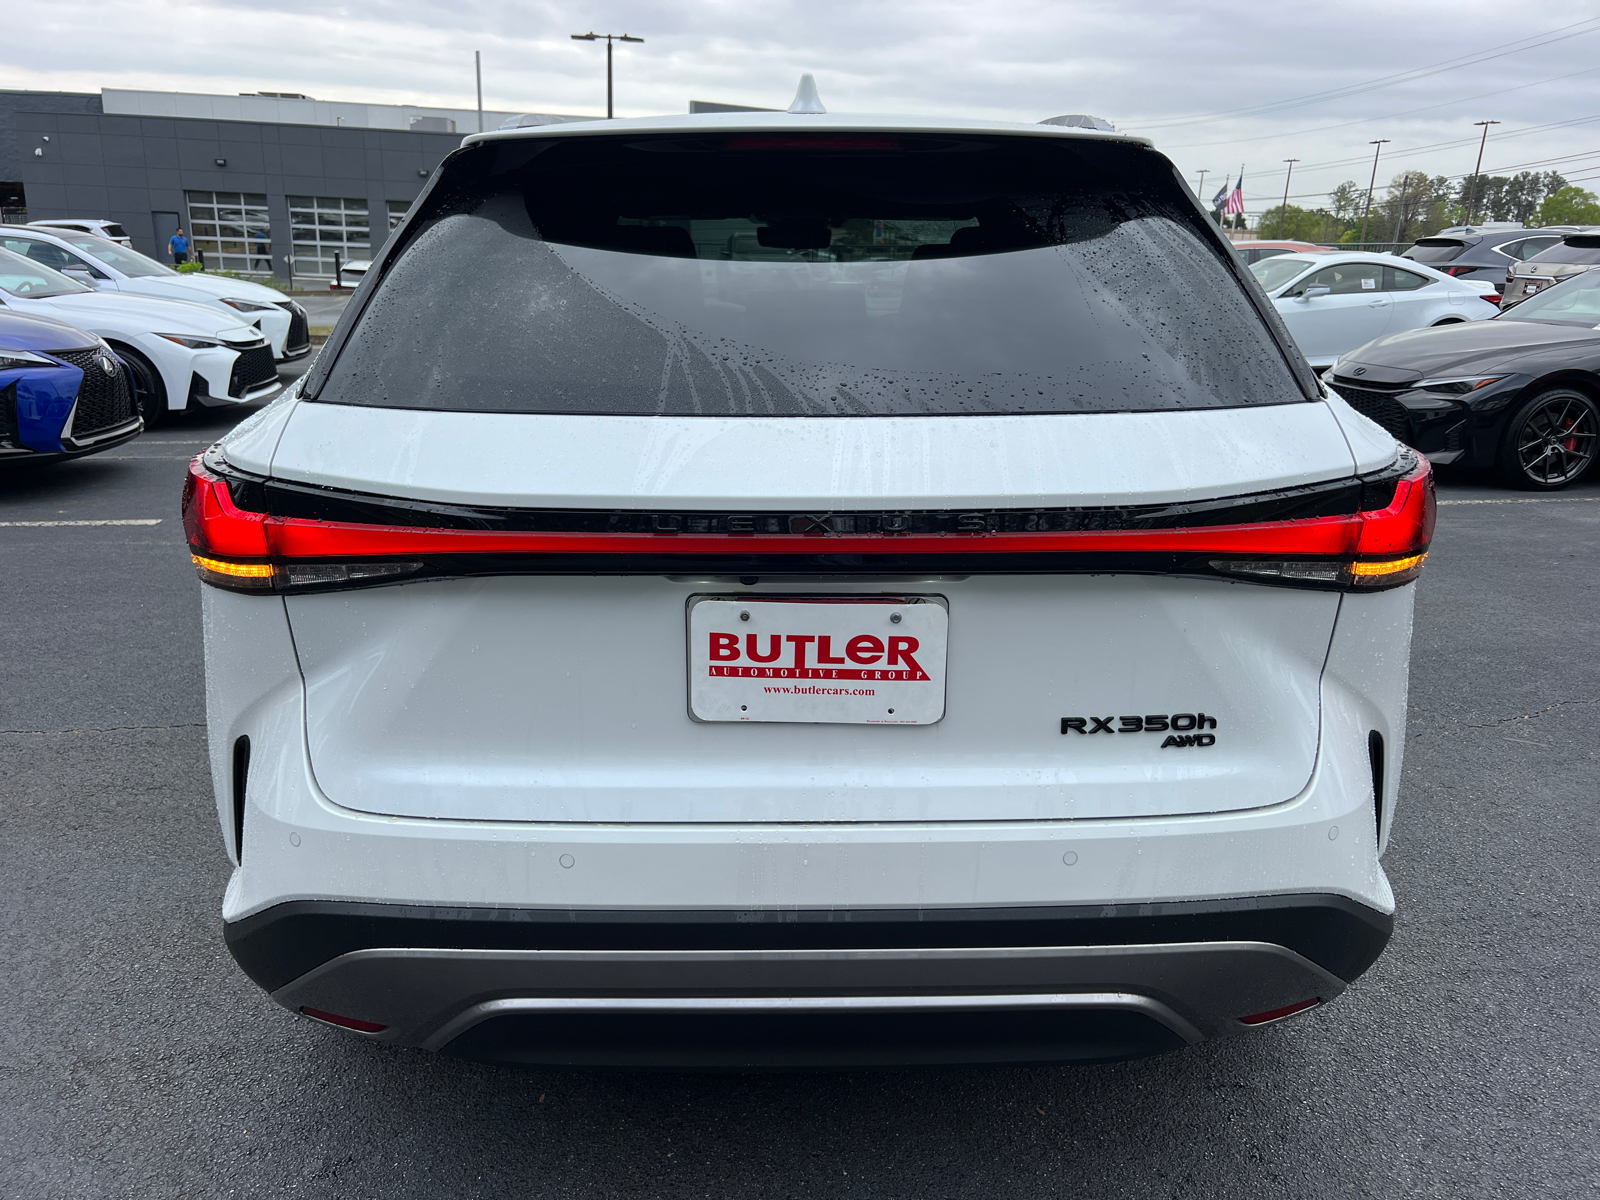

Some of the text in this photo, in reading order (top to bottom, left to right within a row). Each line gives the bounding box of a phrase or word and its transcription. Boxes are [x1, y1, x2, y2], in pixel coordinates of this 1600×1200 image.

[652, 513, 986, 531] LEXUS
[710, 666, 923, 680] AUTOMOTIVE GROUP
[763, 685, 876, 697] www.butlercars.com
[1160, 733, 1216, 749] AWD
